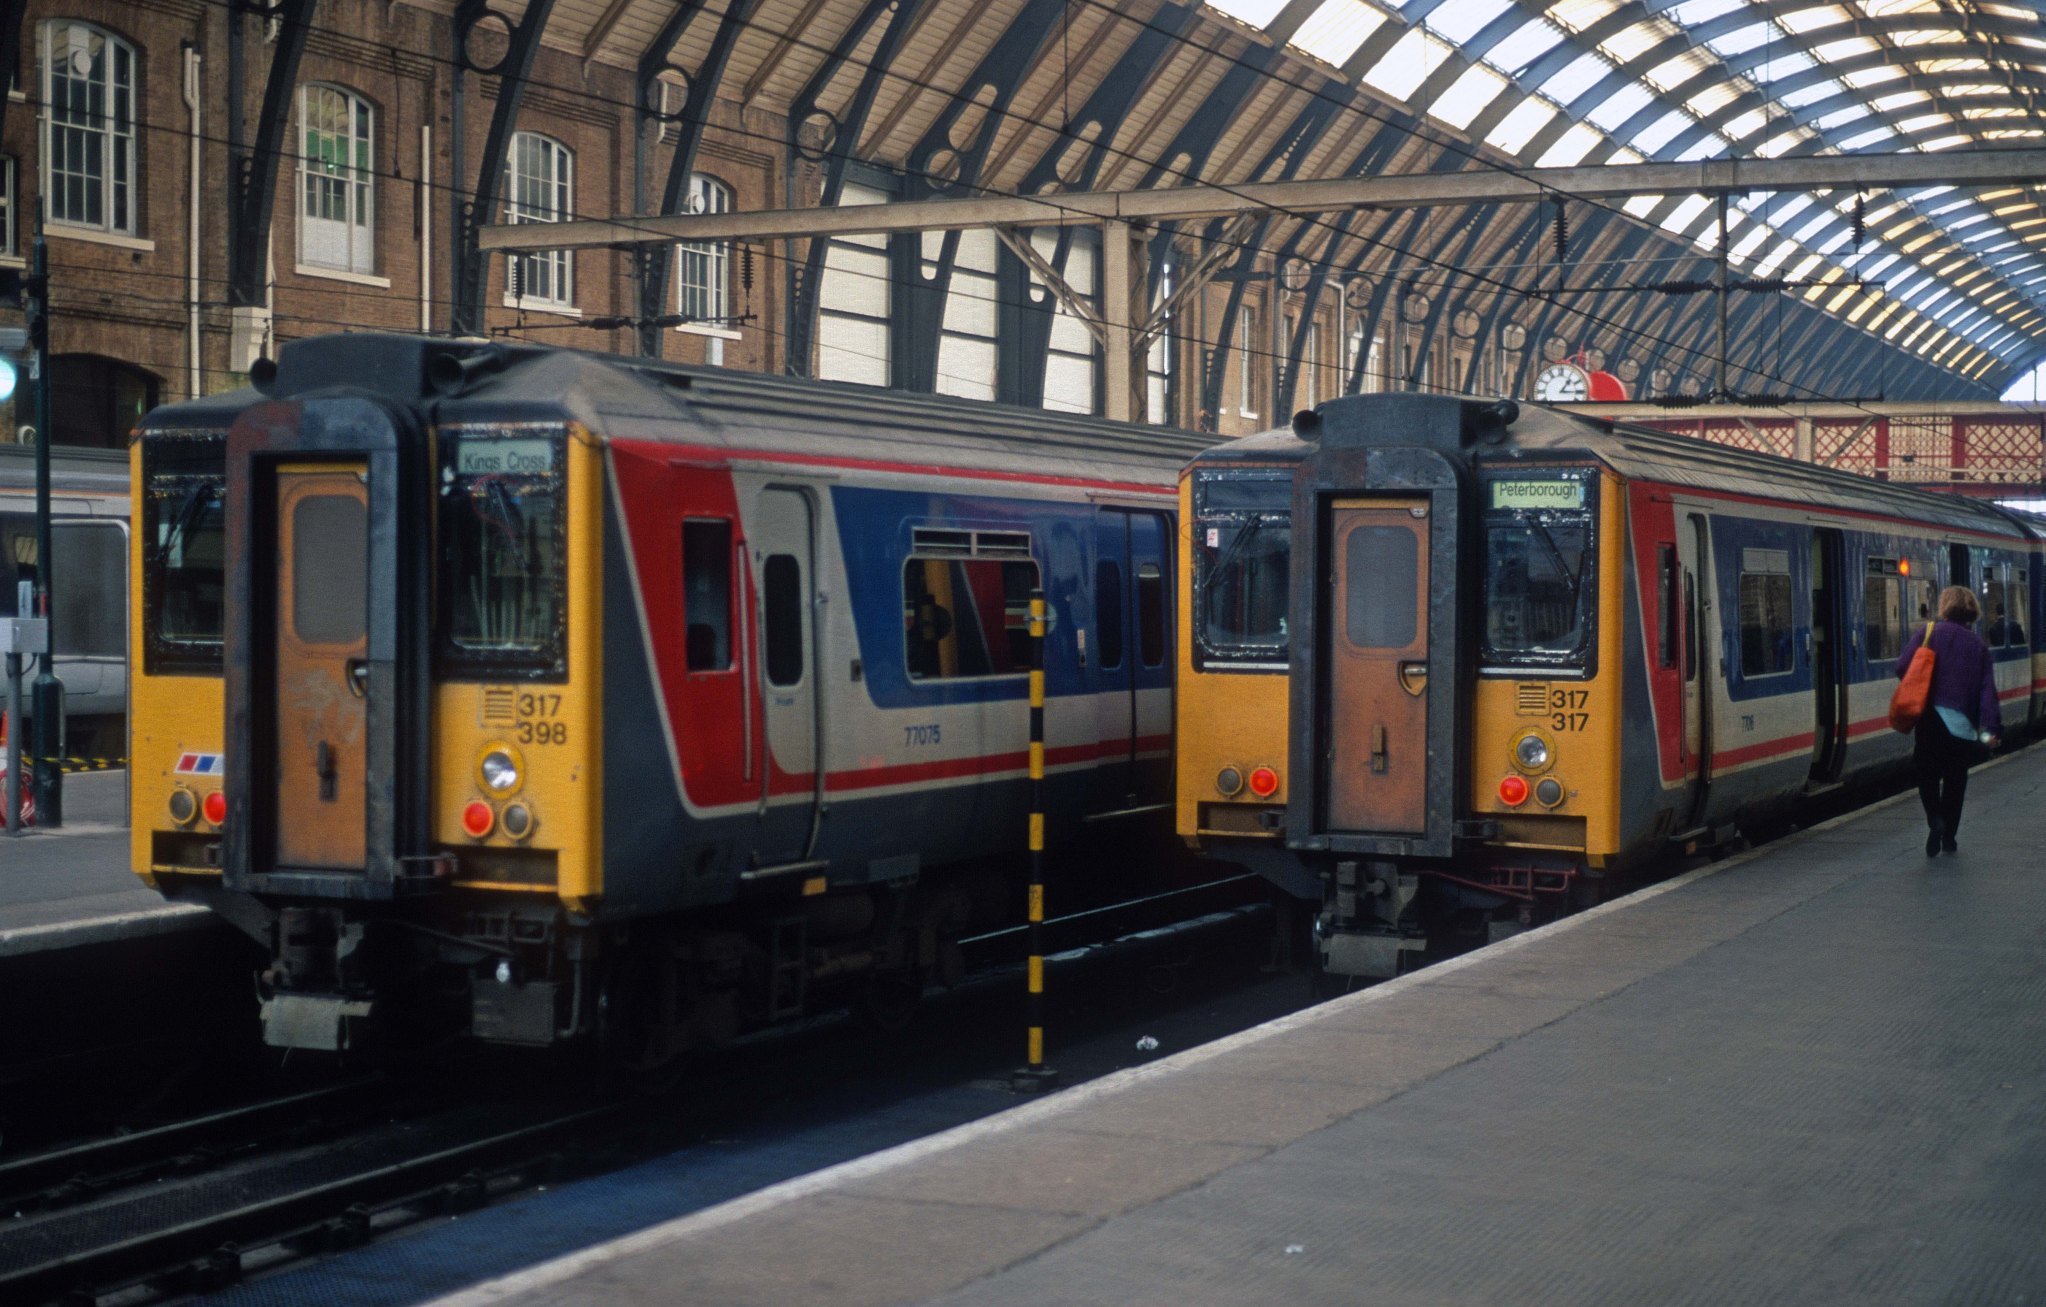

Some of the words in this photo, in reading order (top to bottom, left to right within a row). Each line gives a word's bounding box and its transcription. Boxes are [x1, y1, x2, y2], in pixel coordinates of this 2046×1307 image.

[464, 453, 500, 470] Kings
[507, 451, 545, 470] Cross
[1500, 483, 1577, 499] Peterborough
[519, 694, 562, 717] 317
[1552, 690, 1589, 709] 317
[1552, 712, 1589, 732] 317
[517, 722, 567, 745] 398
[903, 724, 941, 747] 77075
